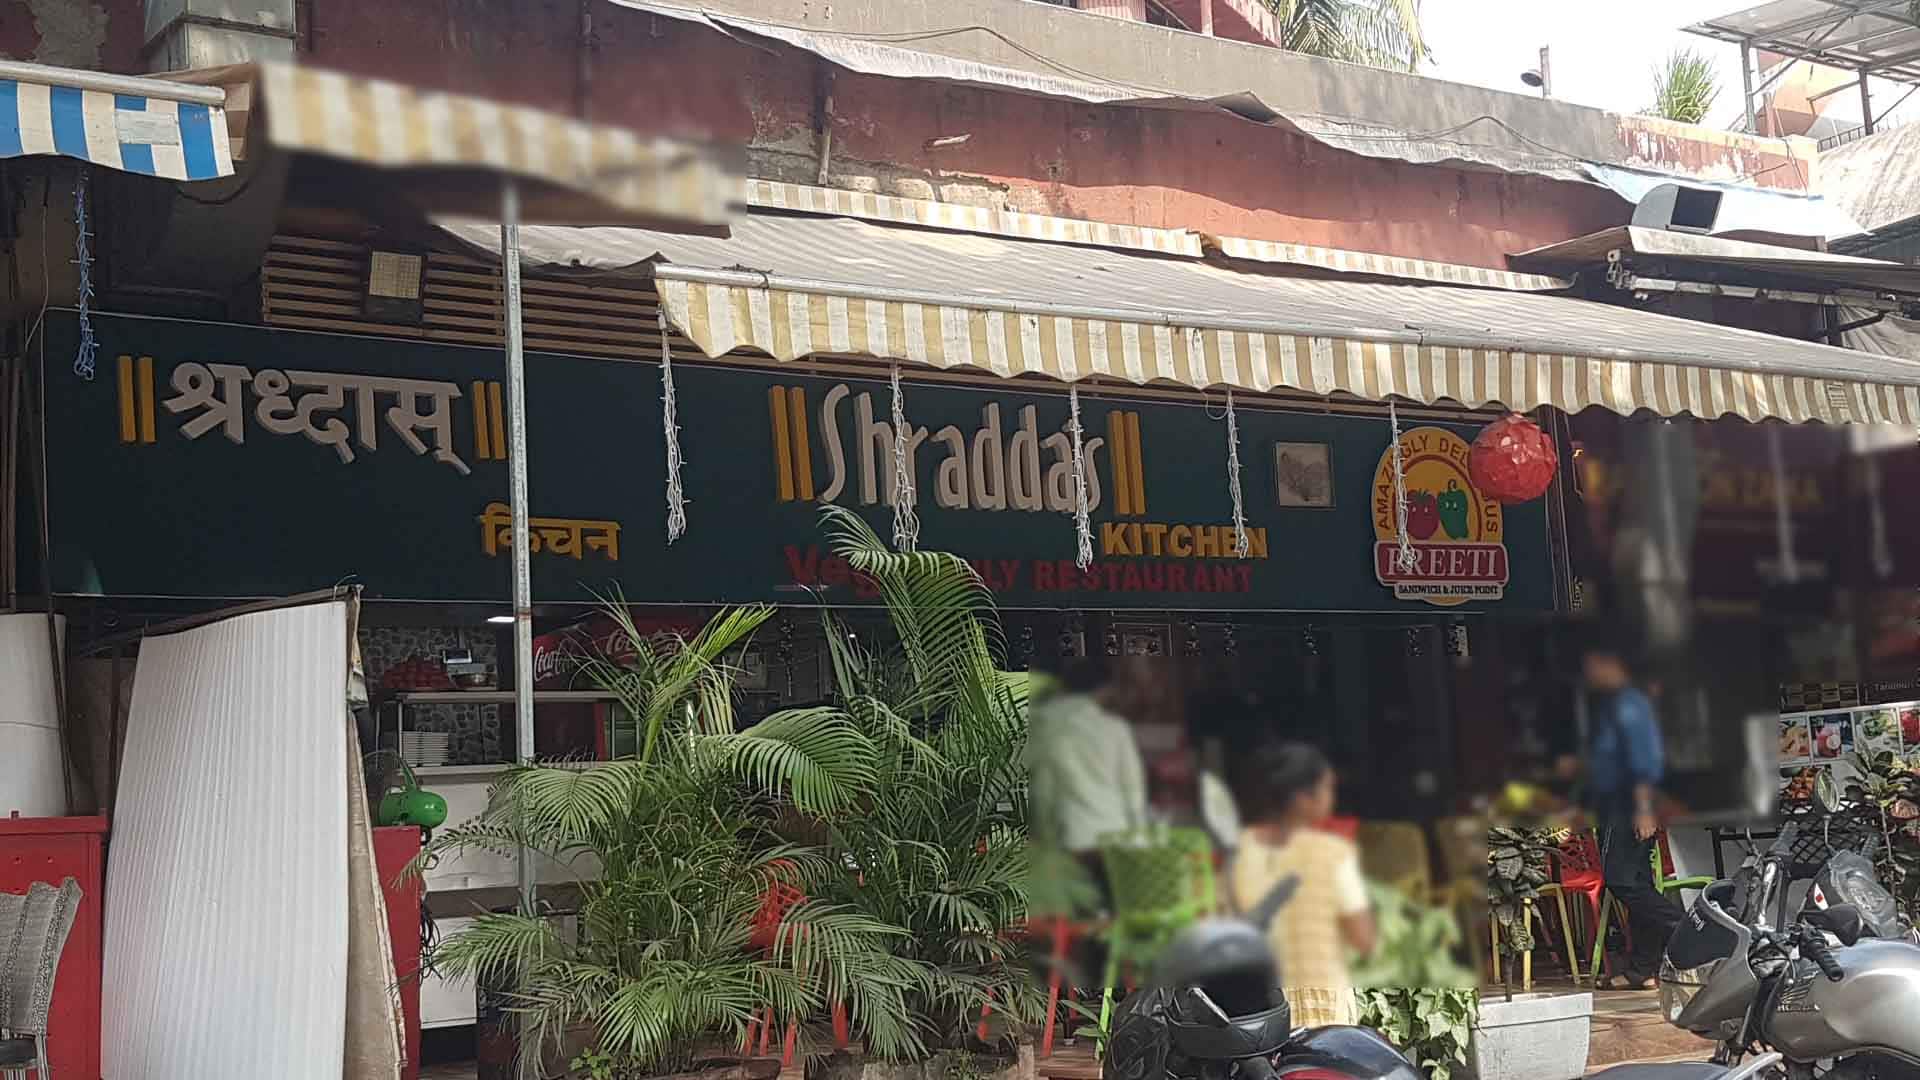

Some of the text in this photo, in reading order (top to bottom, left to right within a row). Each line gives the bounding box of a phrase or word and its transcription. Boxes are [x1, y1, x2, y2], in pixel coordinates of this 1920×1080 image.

[1376, 435, 1499, 533] AMAZGLY DELUS
[1102, 522, 1267, 560] KITCHEN
[1030, 558, 1255, 593] RESTAURANT
[1386, 547, 1498, 577] PREETI
